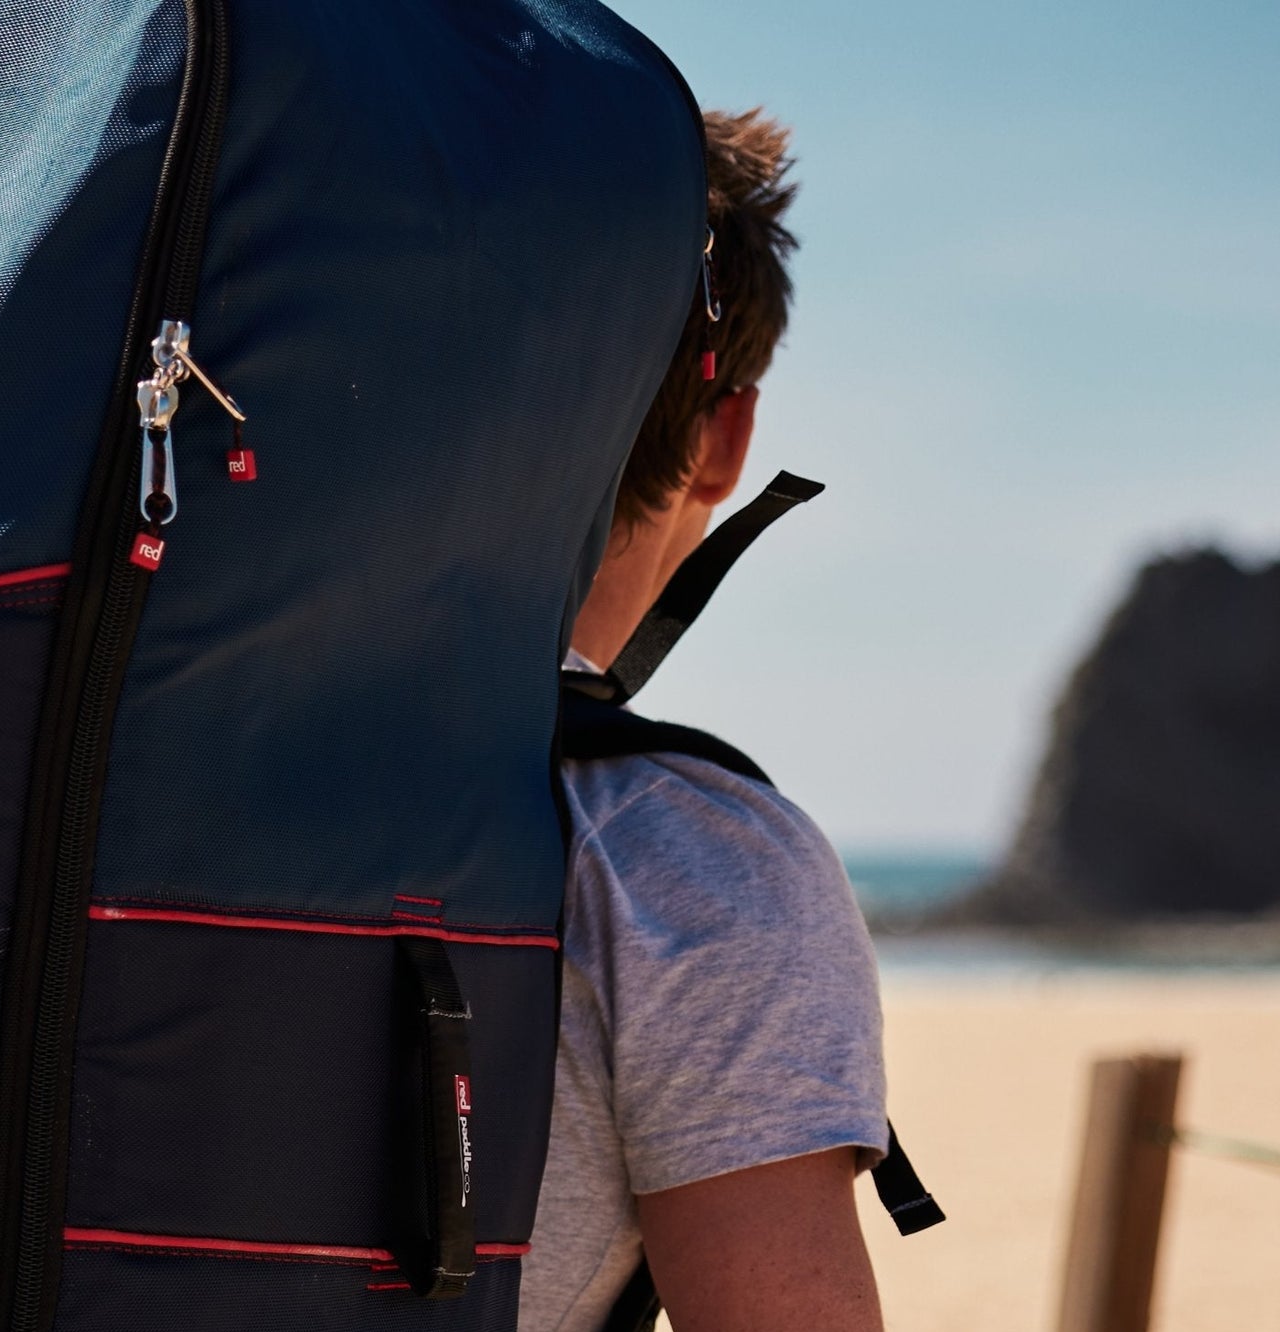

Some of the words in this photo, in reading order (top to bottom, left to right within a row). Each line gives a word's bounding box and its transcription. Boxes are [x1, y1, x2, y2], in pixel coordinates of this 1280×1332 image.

[229, 451, 245, 472] red
[139, 540, 164, 561] red
[458, 1081, 471, 1110] red
[460, 1116, 472, 1173] paddle
